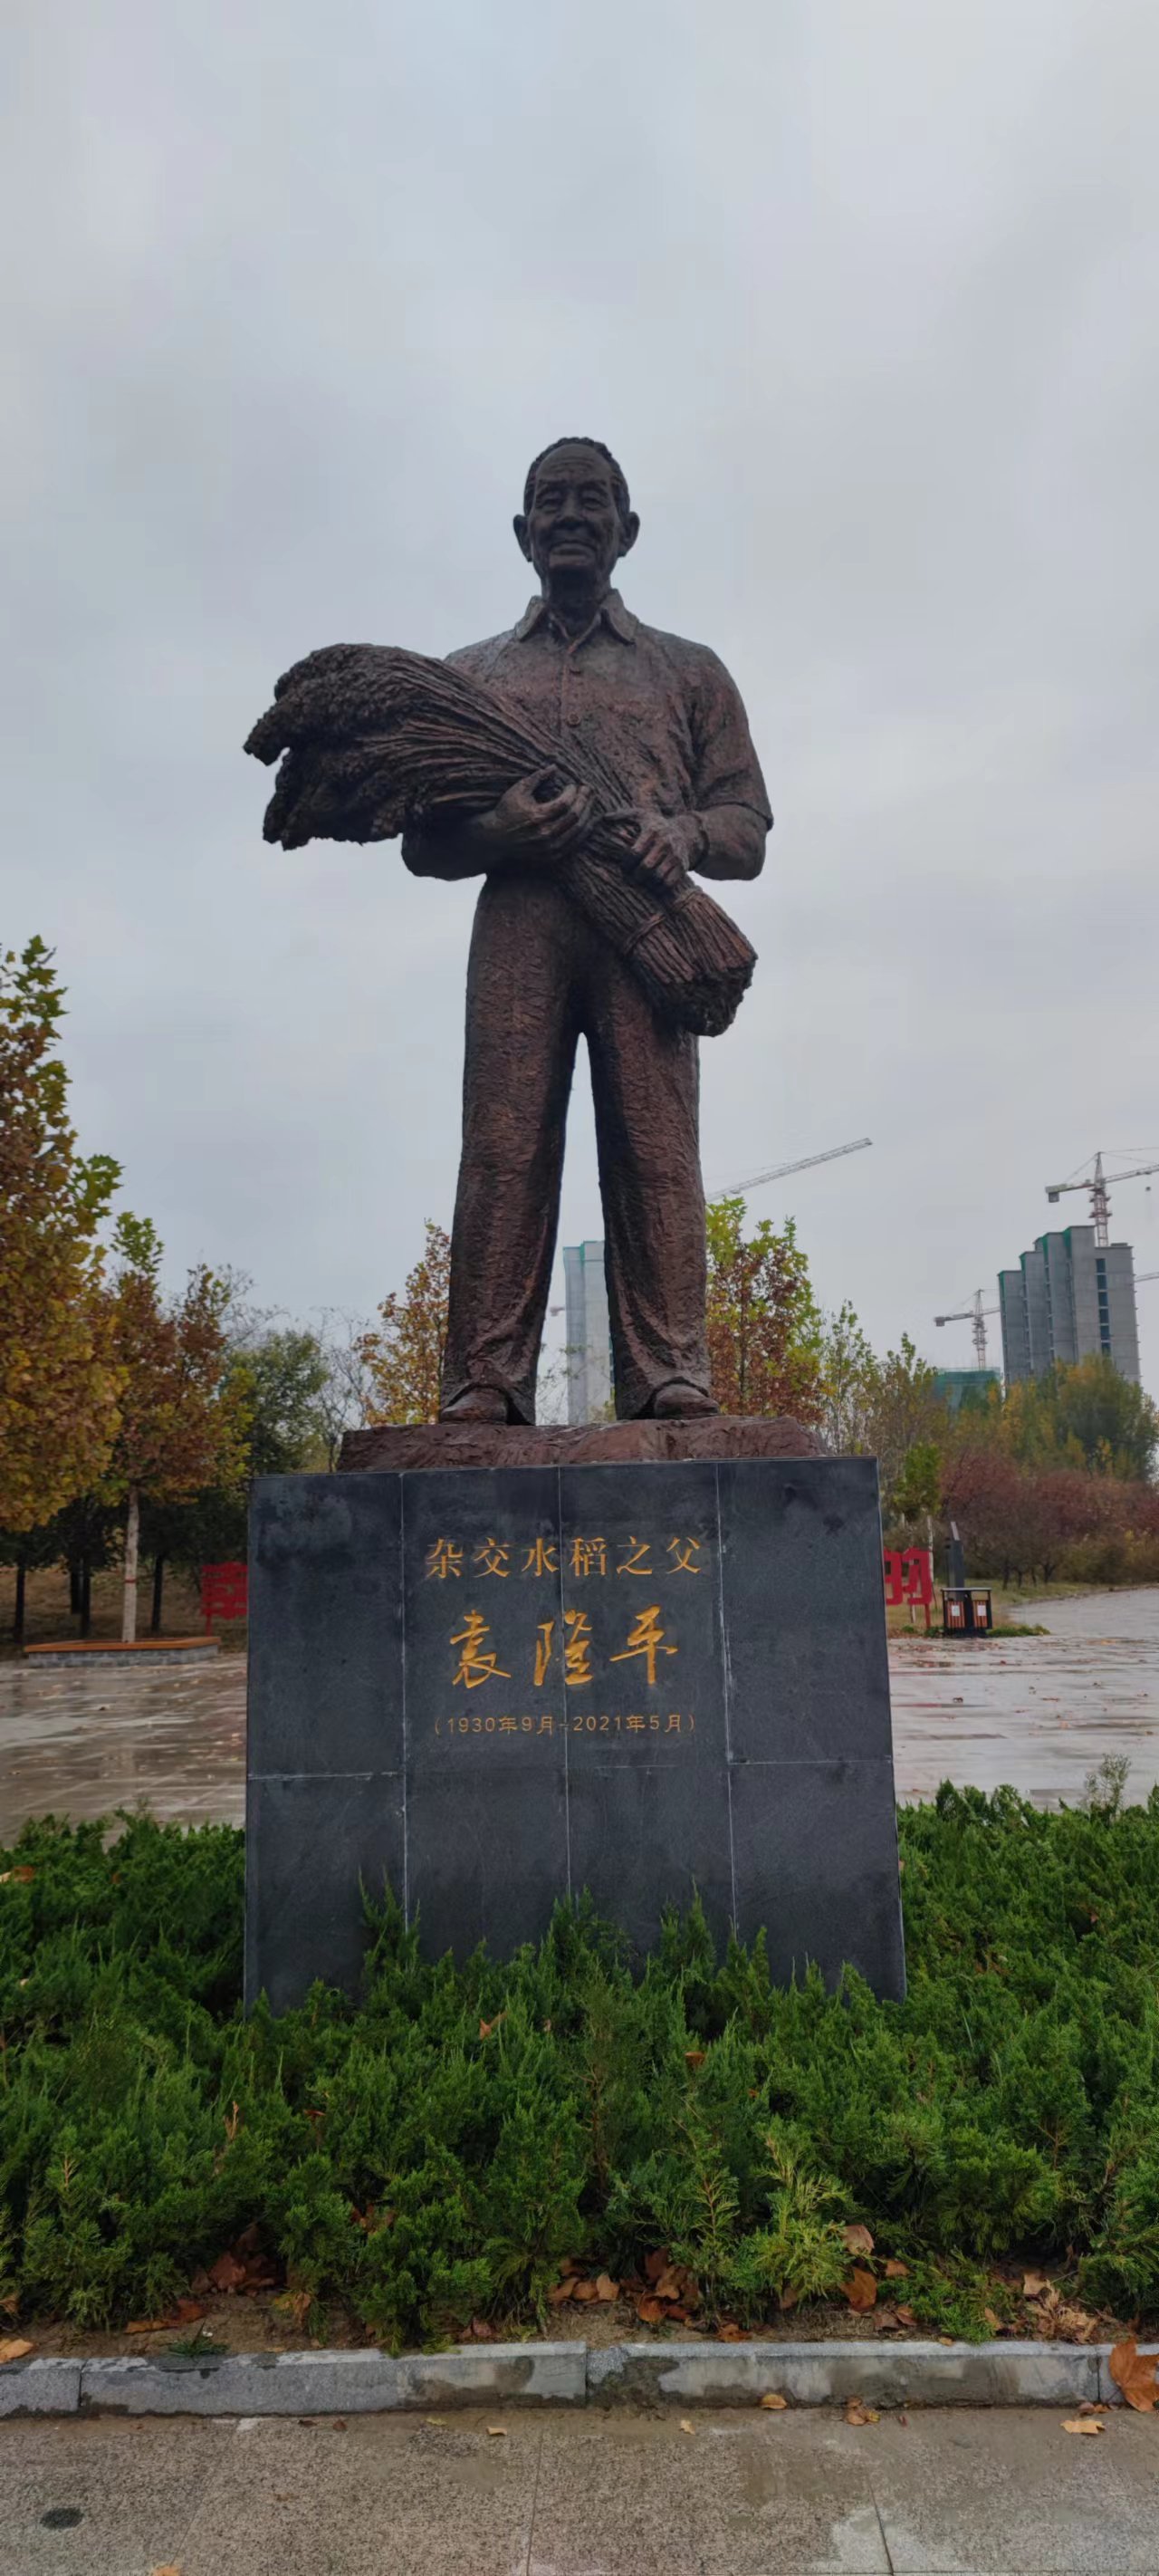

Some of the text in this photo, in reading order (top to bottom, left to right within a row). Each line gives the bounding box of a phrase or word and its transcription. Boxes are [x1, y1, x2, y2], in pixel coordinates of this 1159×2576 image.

[426, 1537, 701, 1578] 杂交水稻之父
[450, 1605, 678, 1688] 袁隆平
